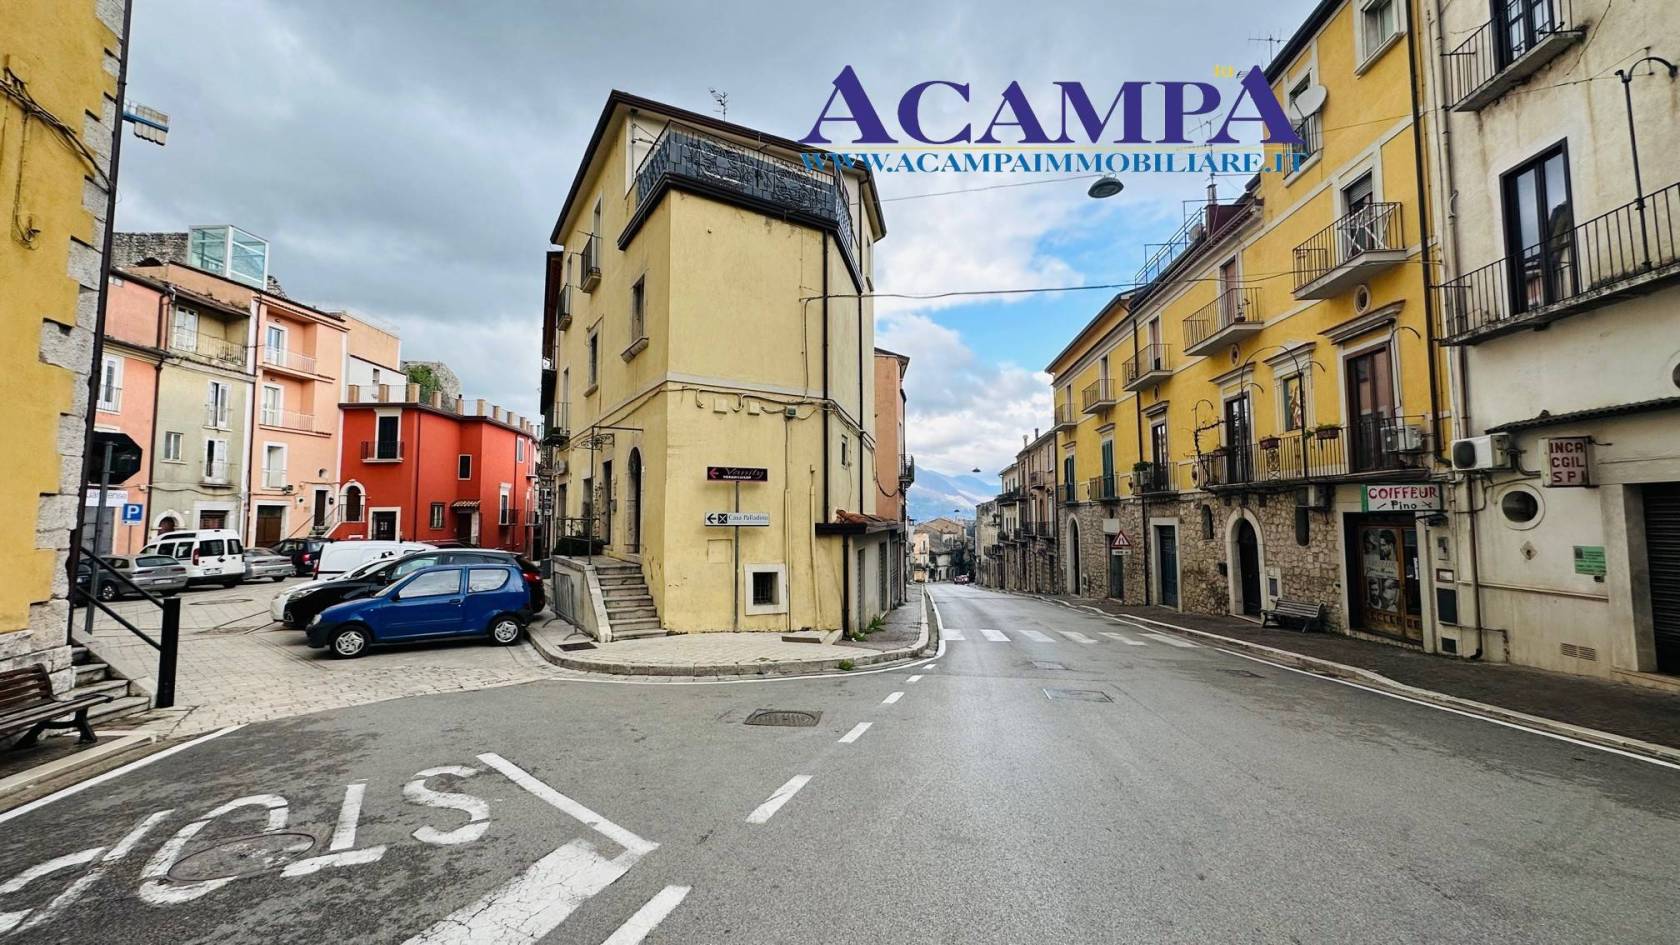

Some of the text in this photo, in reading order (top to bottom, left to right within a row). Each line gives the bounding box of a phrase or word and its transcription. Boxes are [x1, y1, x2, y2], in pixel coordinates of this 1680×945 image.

[1550, 442, 1584, 453] INCA
[1551, 456, 1585, 468] CGIL
[1368, 486, 1438, 499] COIFFEUR
[1391, 500, 1417, 510] Pino
[126, 505, 140, 519] P
